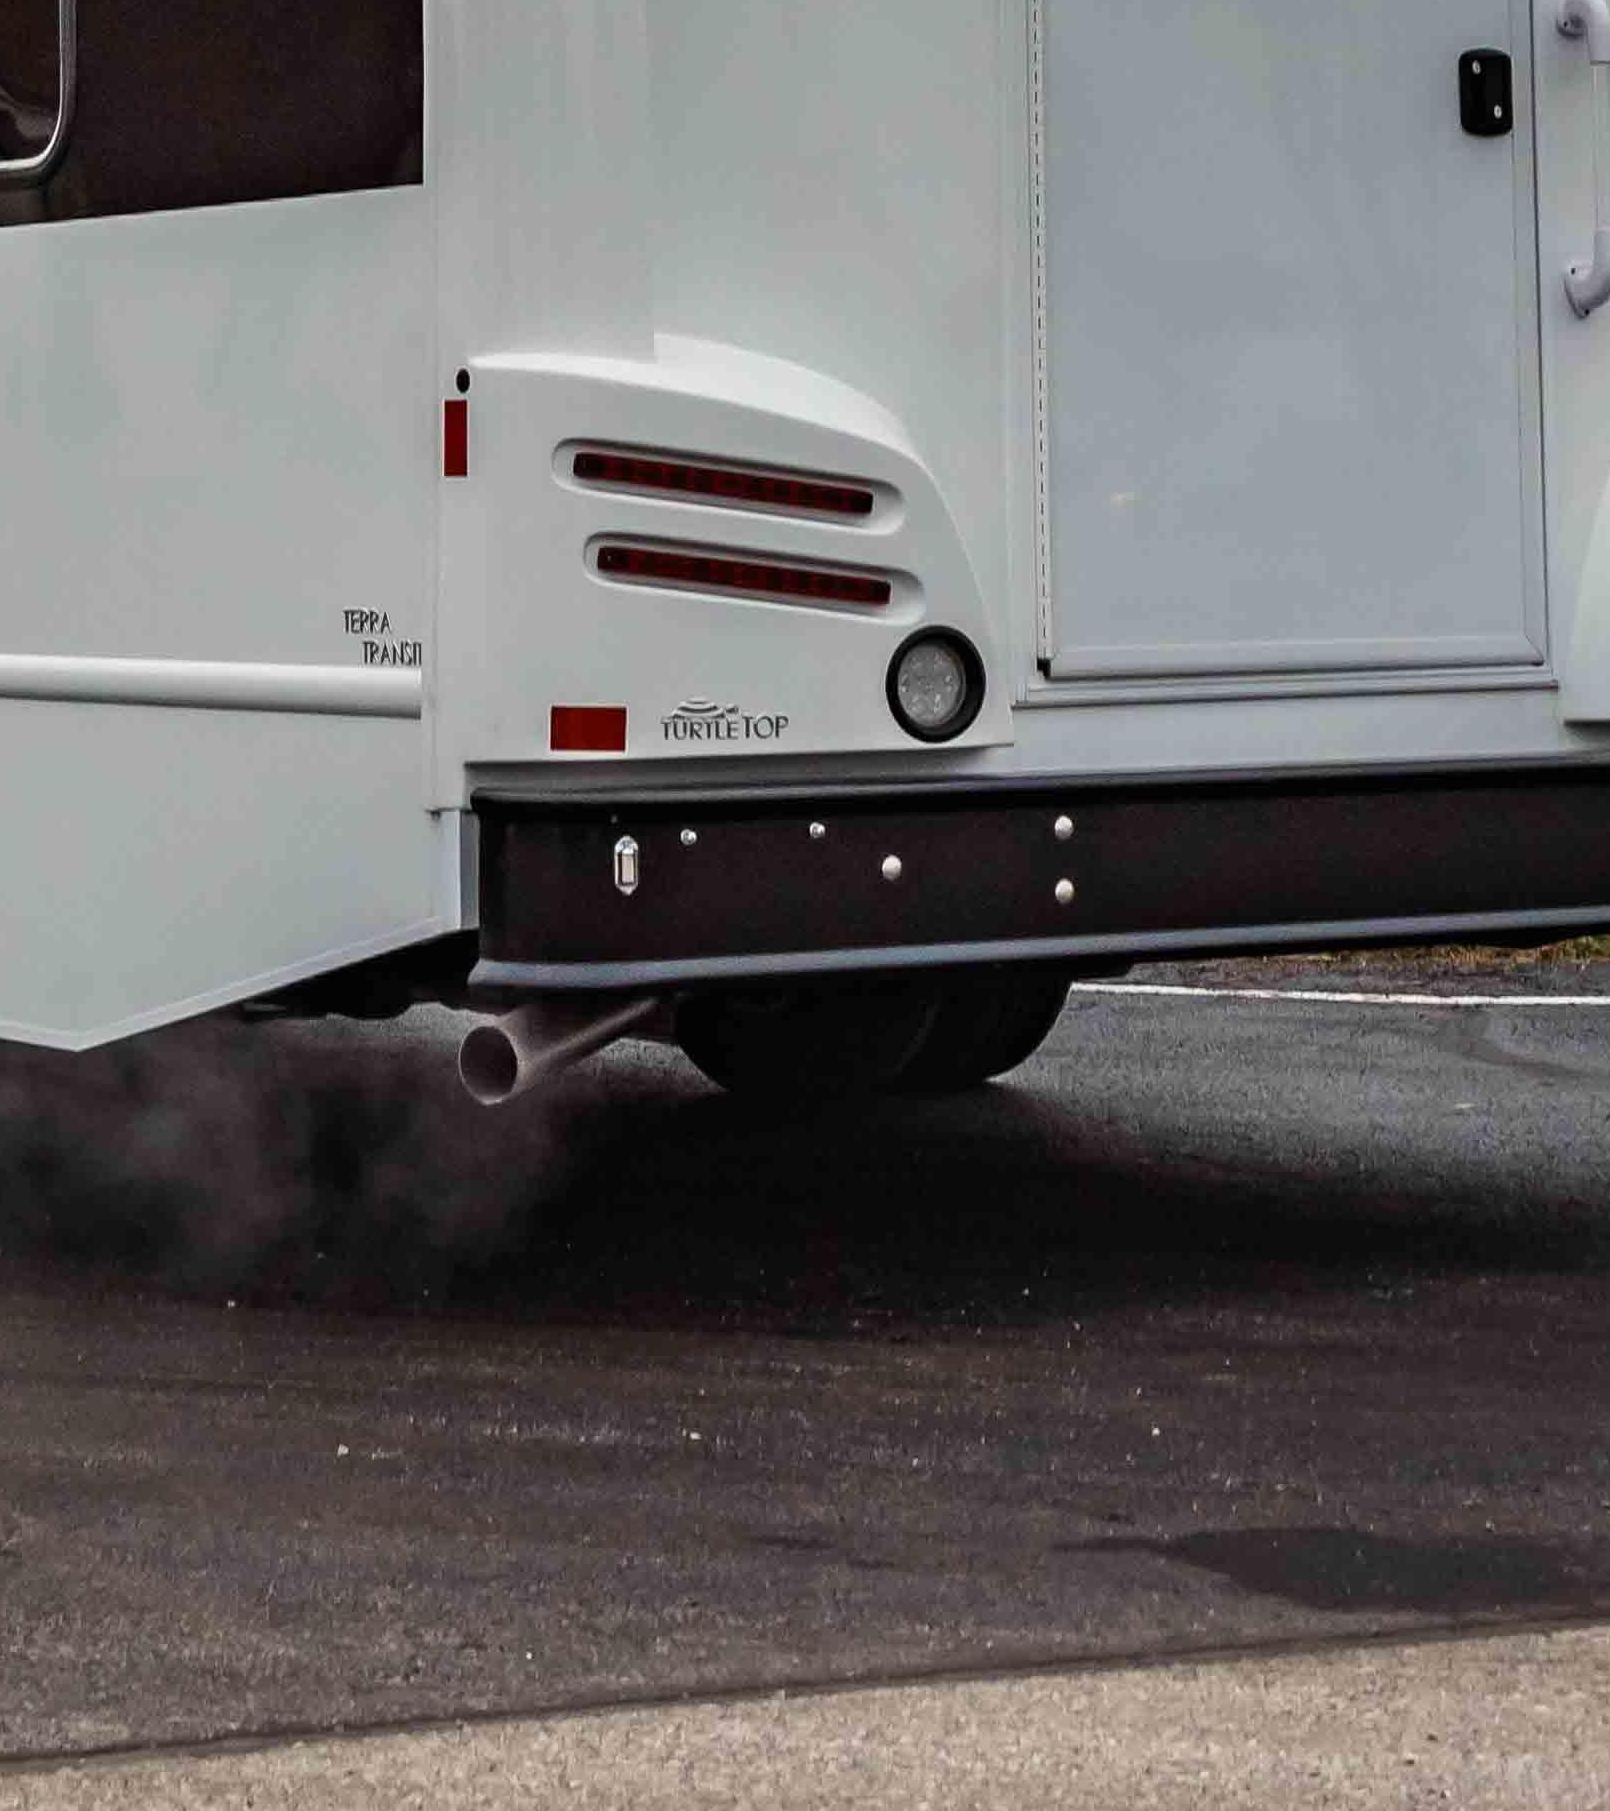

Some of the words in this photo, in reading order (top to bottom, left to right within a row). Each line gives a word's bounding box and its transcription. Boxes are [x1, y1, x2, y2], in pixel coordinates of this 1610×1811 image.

[342, 609, 391, 634] TERRA
[660, 718, 739, 740] TURTLE
[742, 715, 789, 739] TOP
